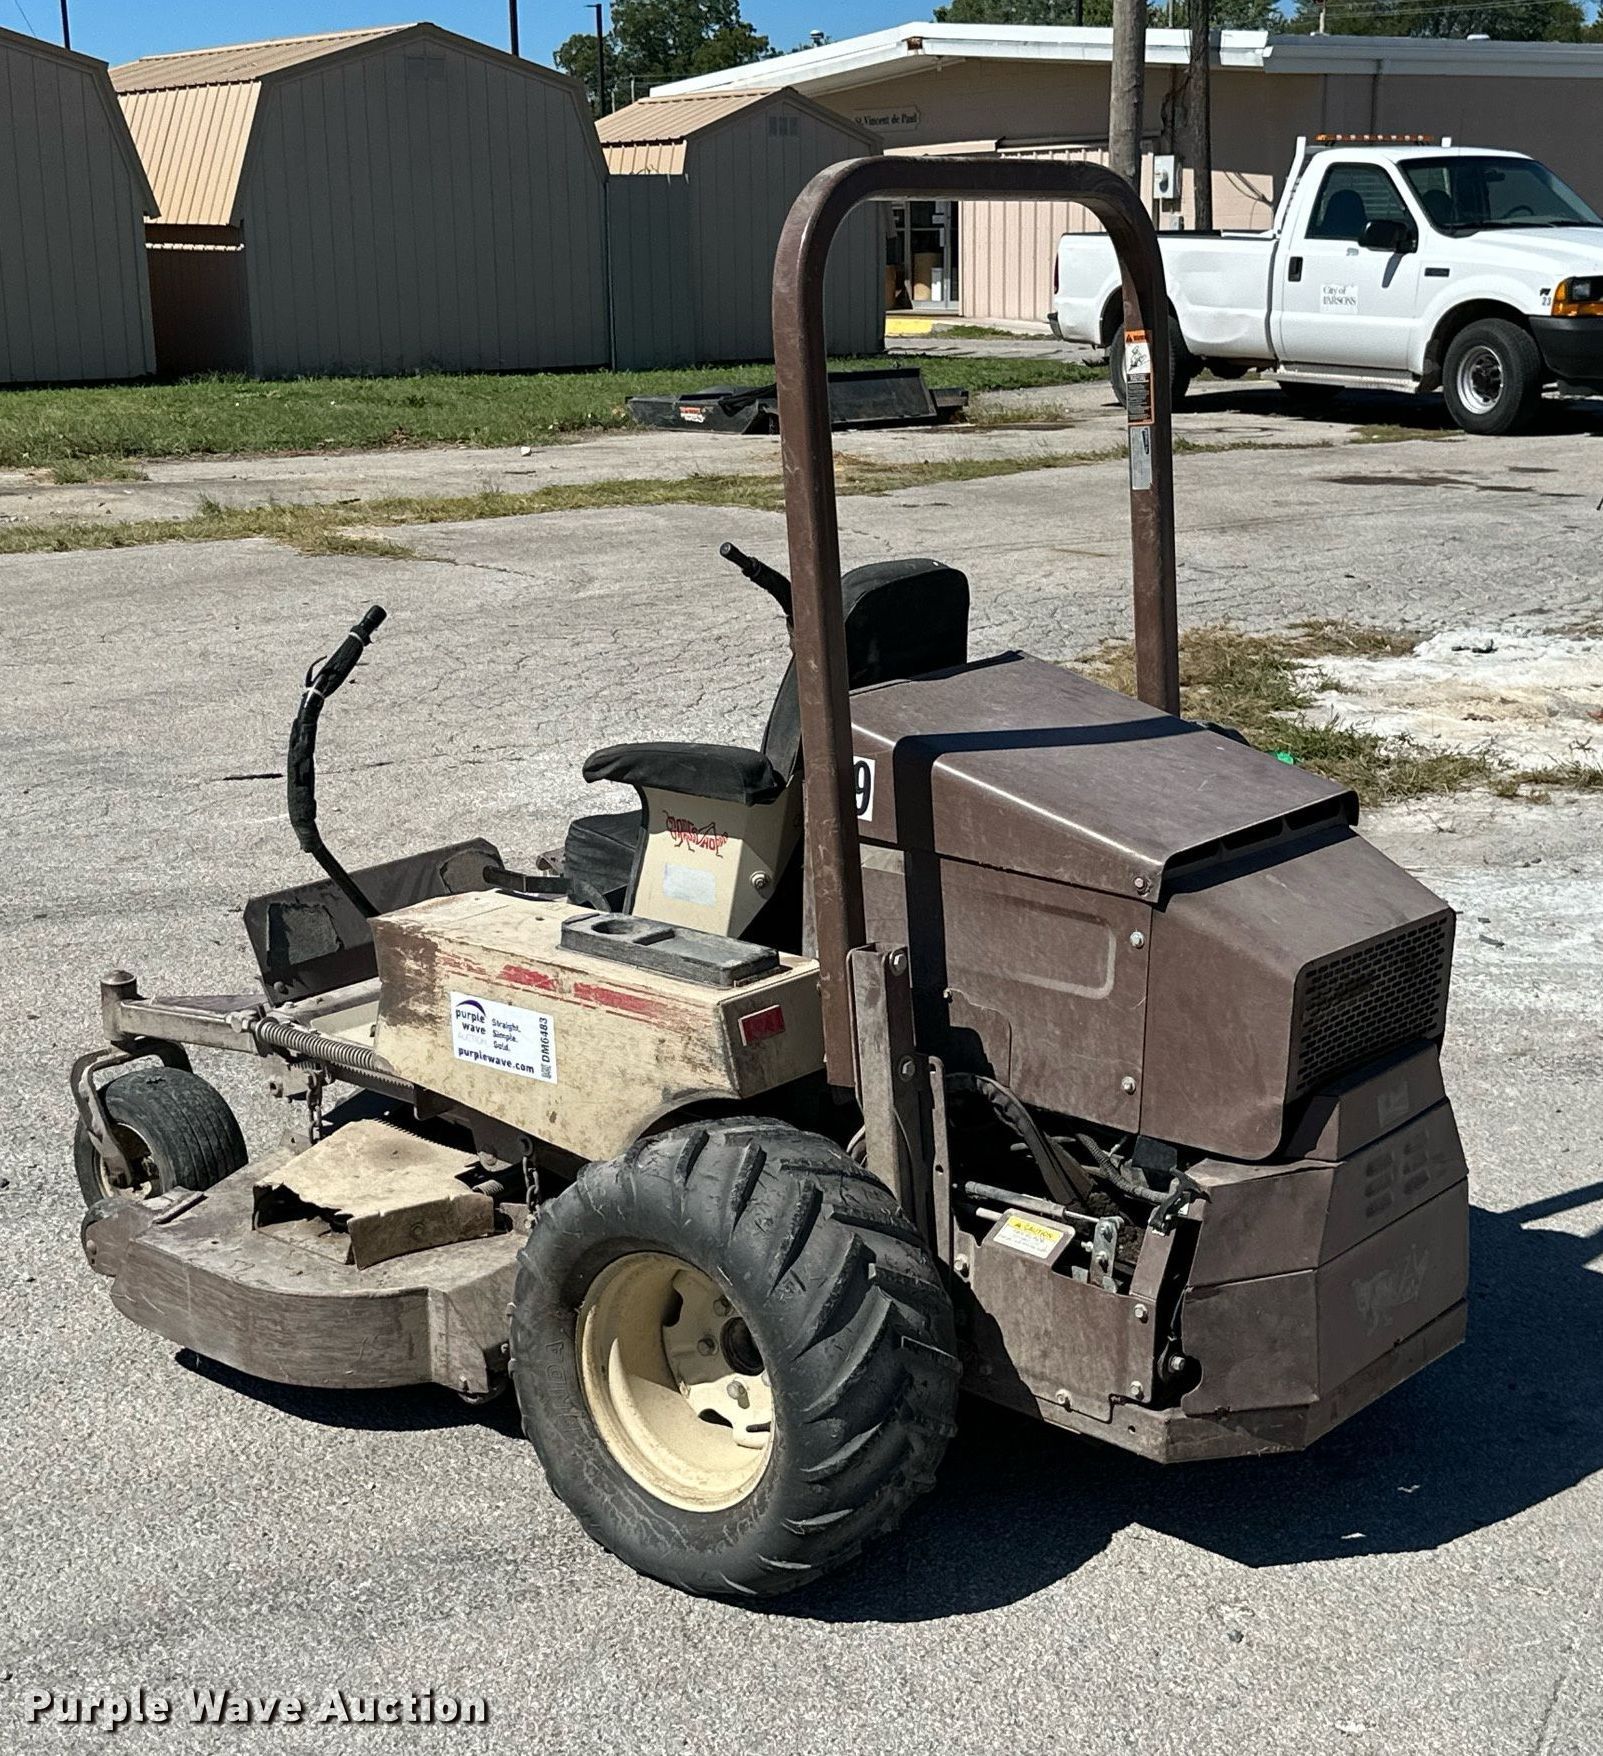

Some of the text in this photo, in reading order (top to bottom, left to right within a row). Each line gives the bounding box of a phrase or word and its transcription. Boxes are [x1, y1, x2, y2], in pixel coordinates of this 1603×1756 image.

[864, 115, 889, 125] Vincent
[891, 114, 901, 124] de
[902, 112, 917, 123] Paul
[1323, 285, 1346, 297] City of
[1323, 296, 1356, 305] PARSONS
[455, 1009, 486, 1023] purple
[461, 1021, 487, 1035] wave
[491, 1017, 521, 1033] Straight.
[538, 1016, 551, 1063] DM6483
[458, 1046, 535, 1075] purplewave.com
